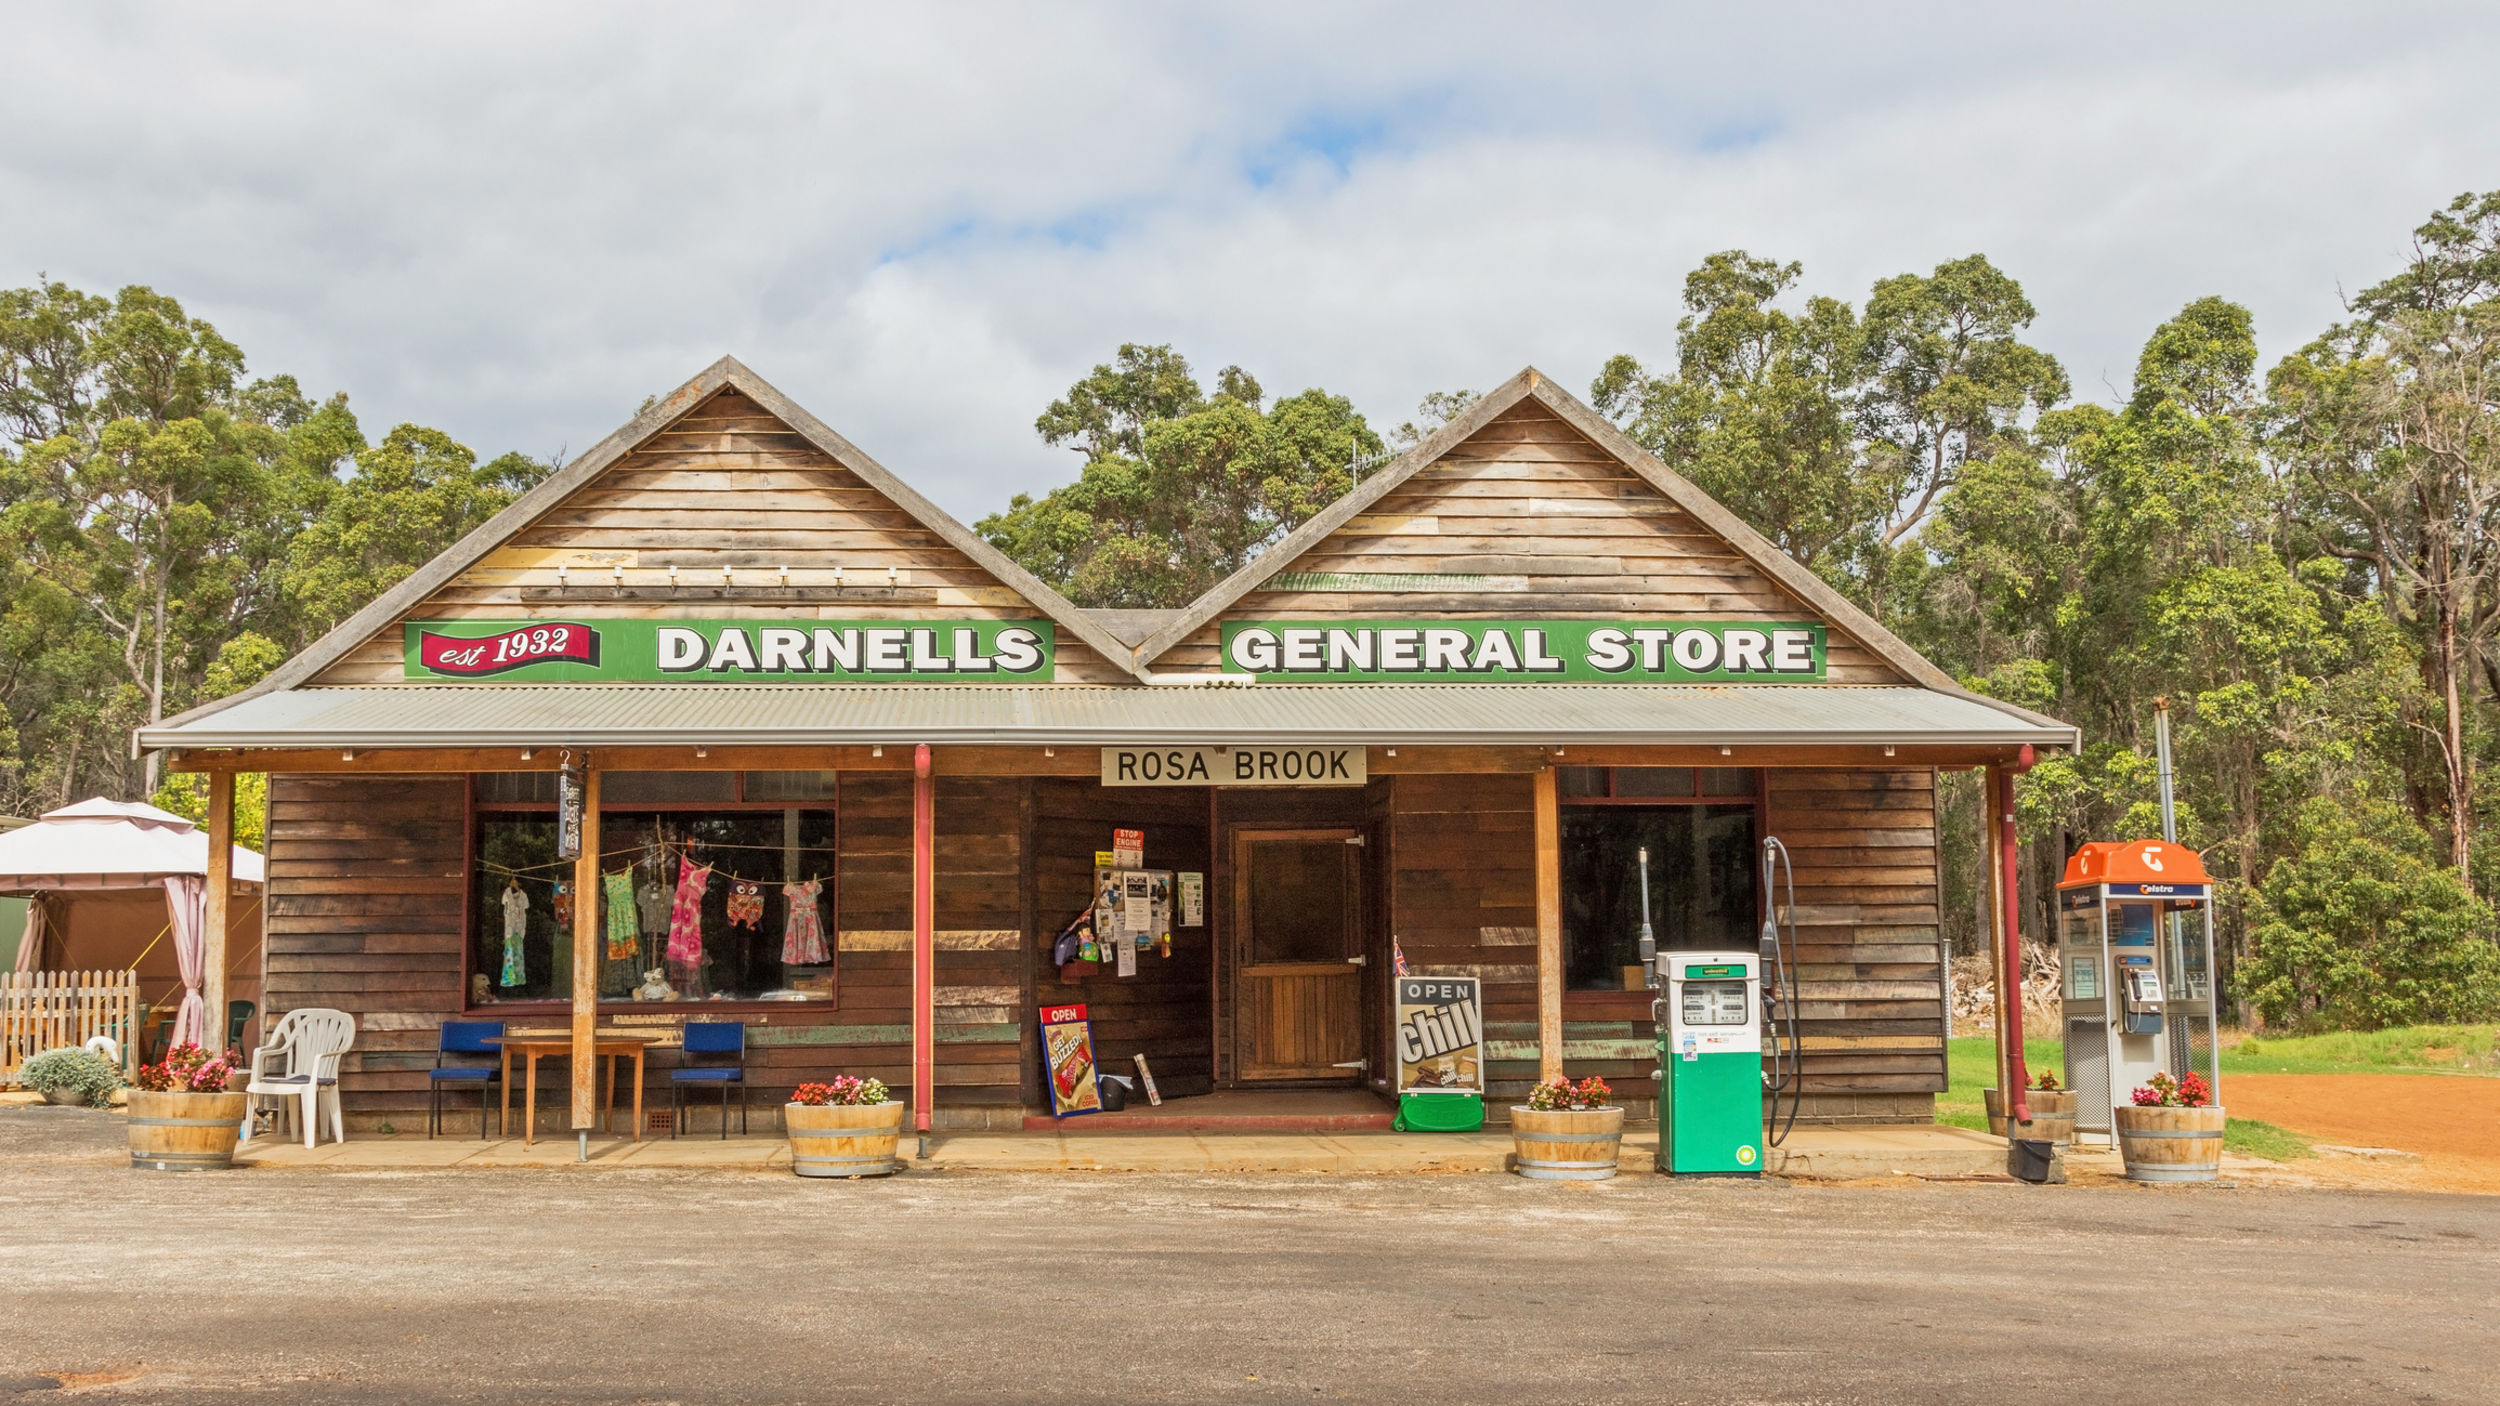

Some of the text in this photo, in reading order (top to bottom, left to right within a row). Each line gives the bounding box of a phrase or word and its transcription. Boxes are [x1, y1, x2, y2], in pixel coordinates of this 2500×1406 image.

[439, 627, 570, 667] est 1932
[656, 626, 1044, 673] DARNELLS
[1230, 627, 1817, 673] GENERAL STORE
[1117, 750, 1350, 780] ROSA BROOK
[1116, 839, 1141, 848] ENGINE
[1120, 829, 1139, 838] STOP
[1408, 984, 1469, 999] OPEN
[1051, 1009, 1077, 1022] OPEN
[1401, 999, 1477, 1064] chill
[1053, 1036, 1065, 1051] GET
